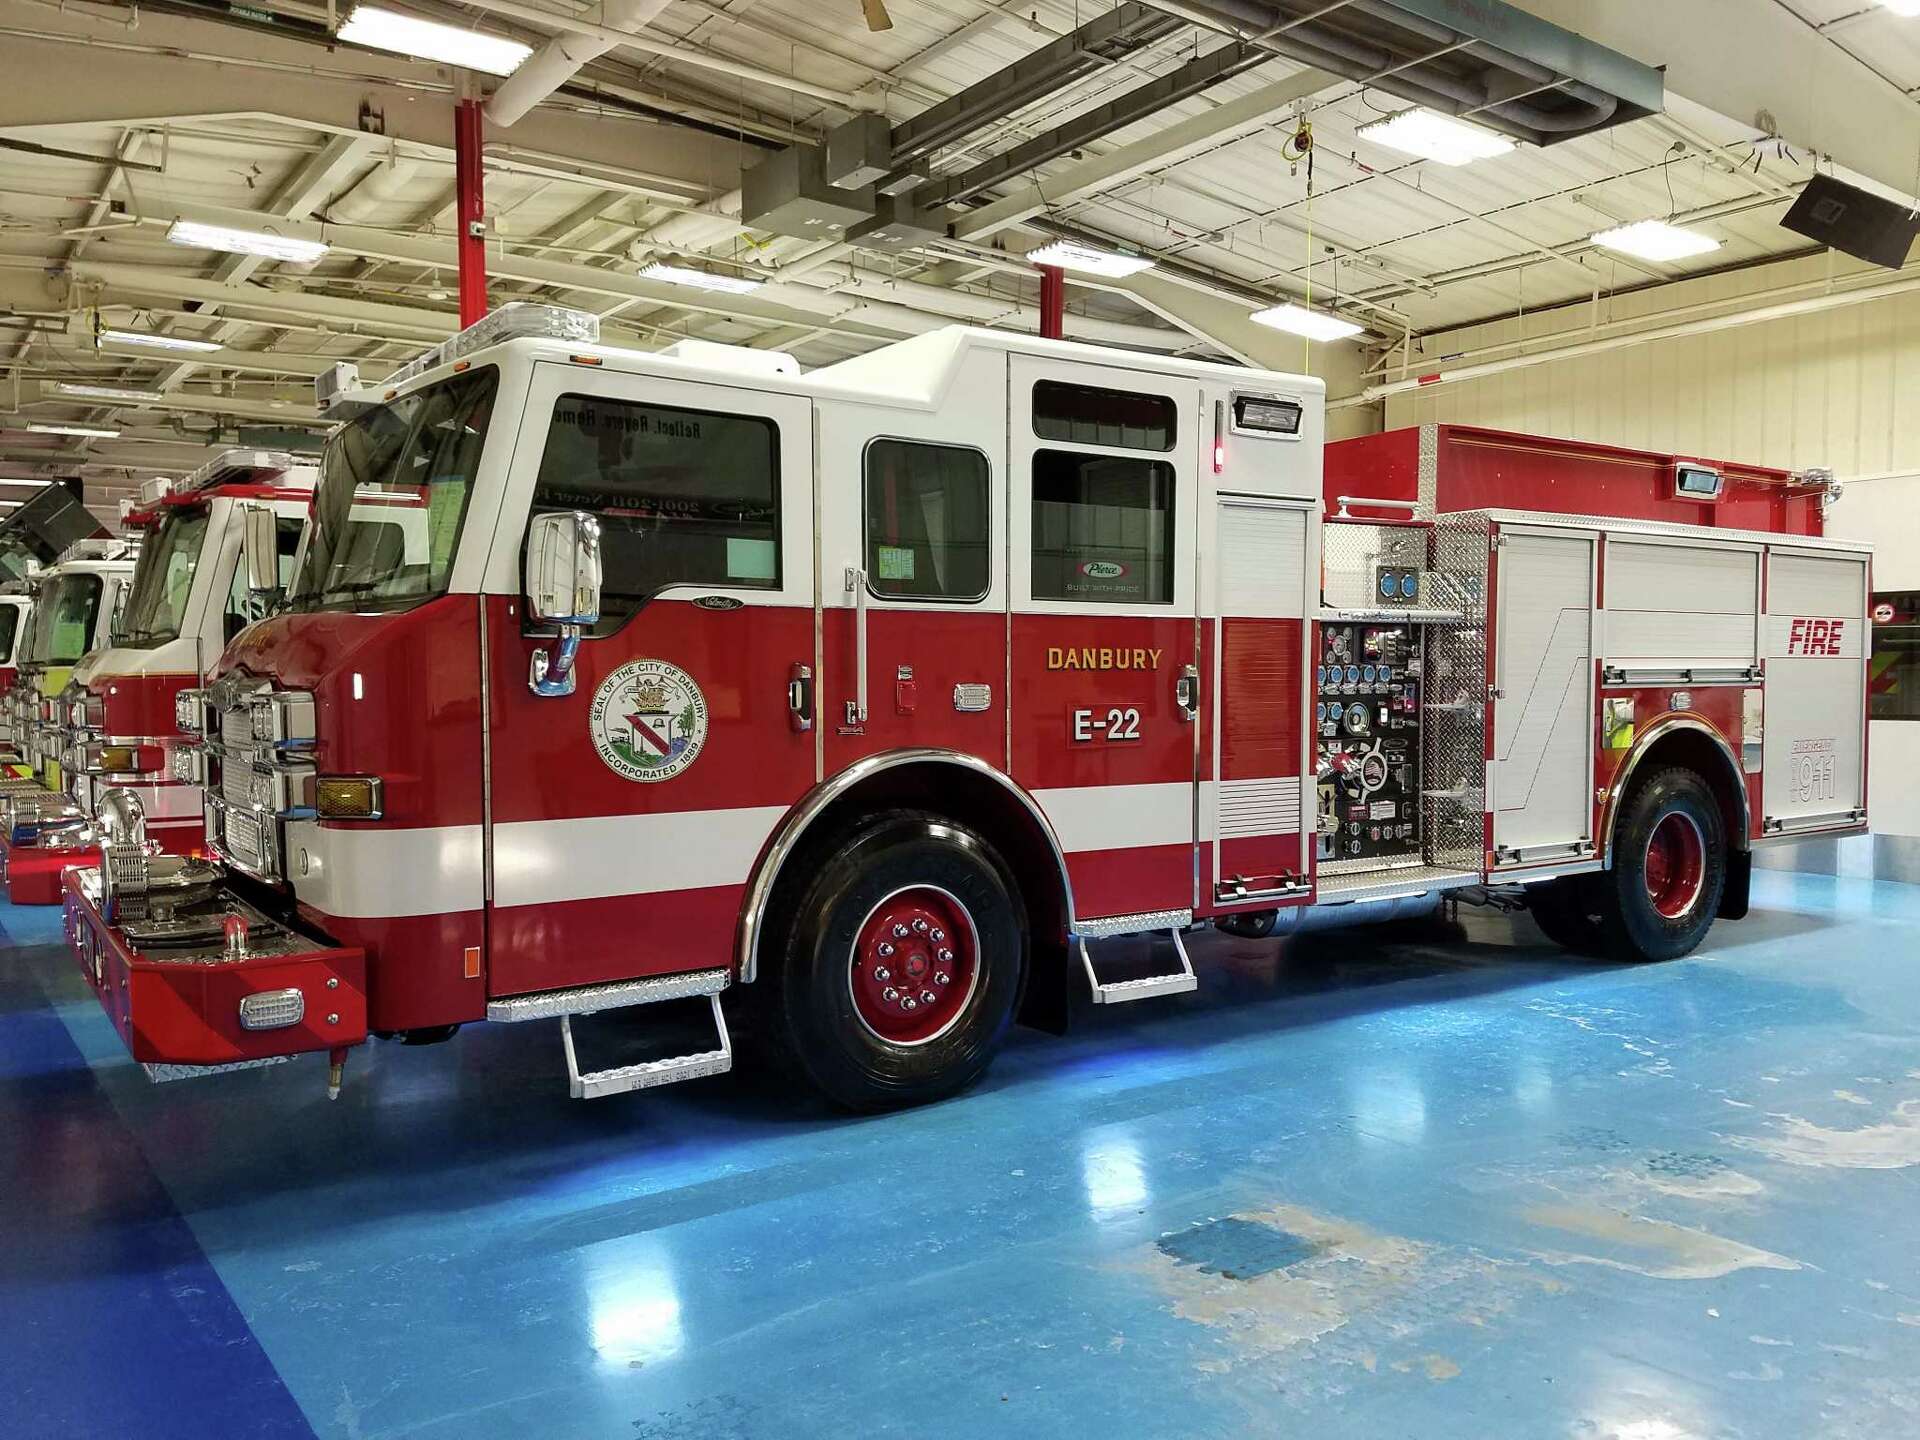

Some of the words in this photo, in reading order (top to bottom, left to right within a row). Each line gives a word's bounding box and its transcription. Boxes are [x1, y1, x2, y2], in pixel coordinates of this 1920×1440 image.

[1787, 618, 1844, 655] FIRE
[1048, 647, 1163, 670] DANBURY
[593, 696, 607, 721] SEAL
[605, 680, 616, 693] OF
[616, 666, 635, 681] THE
[638, 663, 661, 672] CITY
[664, 666, 678, 677] OF
[678, 675, 705, 720] DANBURY
[1074, 708, 1140, 741] E-22
[600, 744, 677, 779] INCORPORATED
[680, 742, 699, 764] 1889
